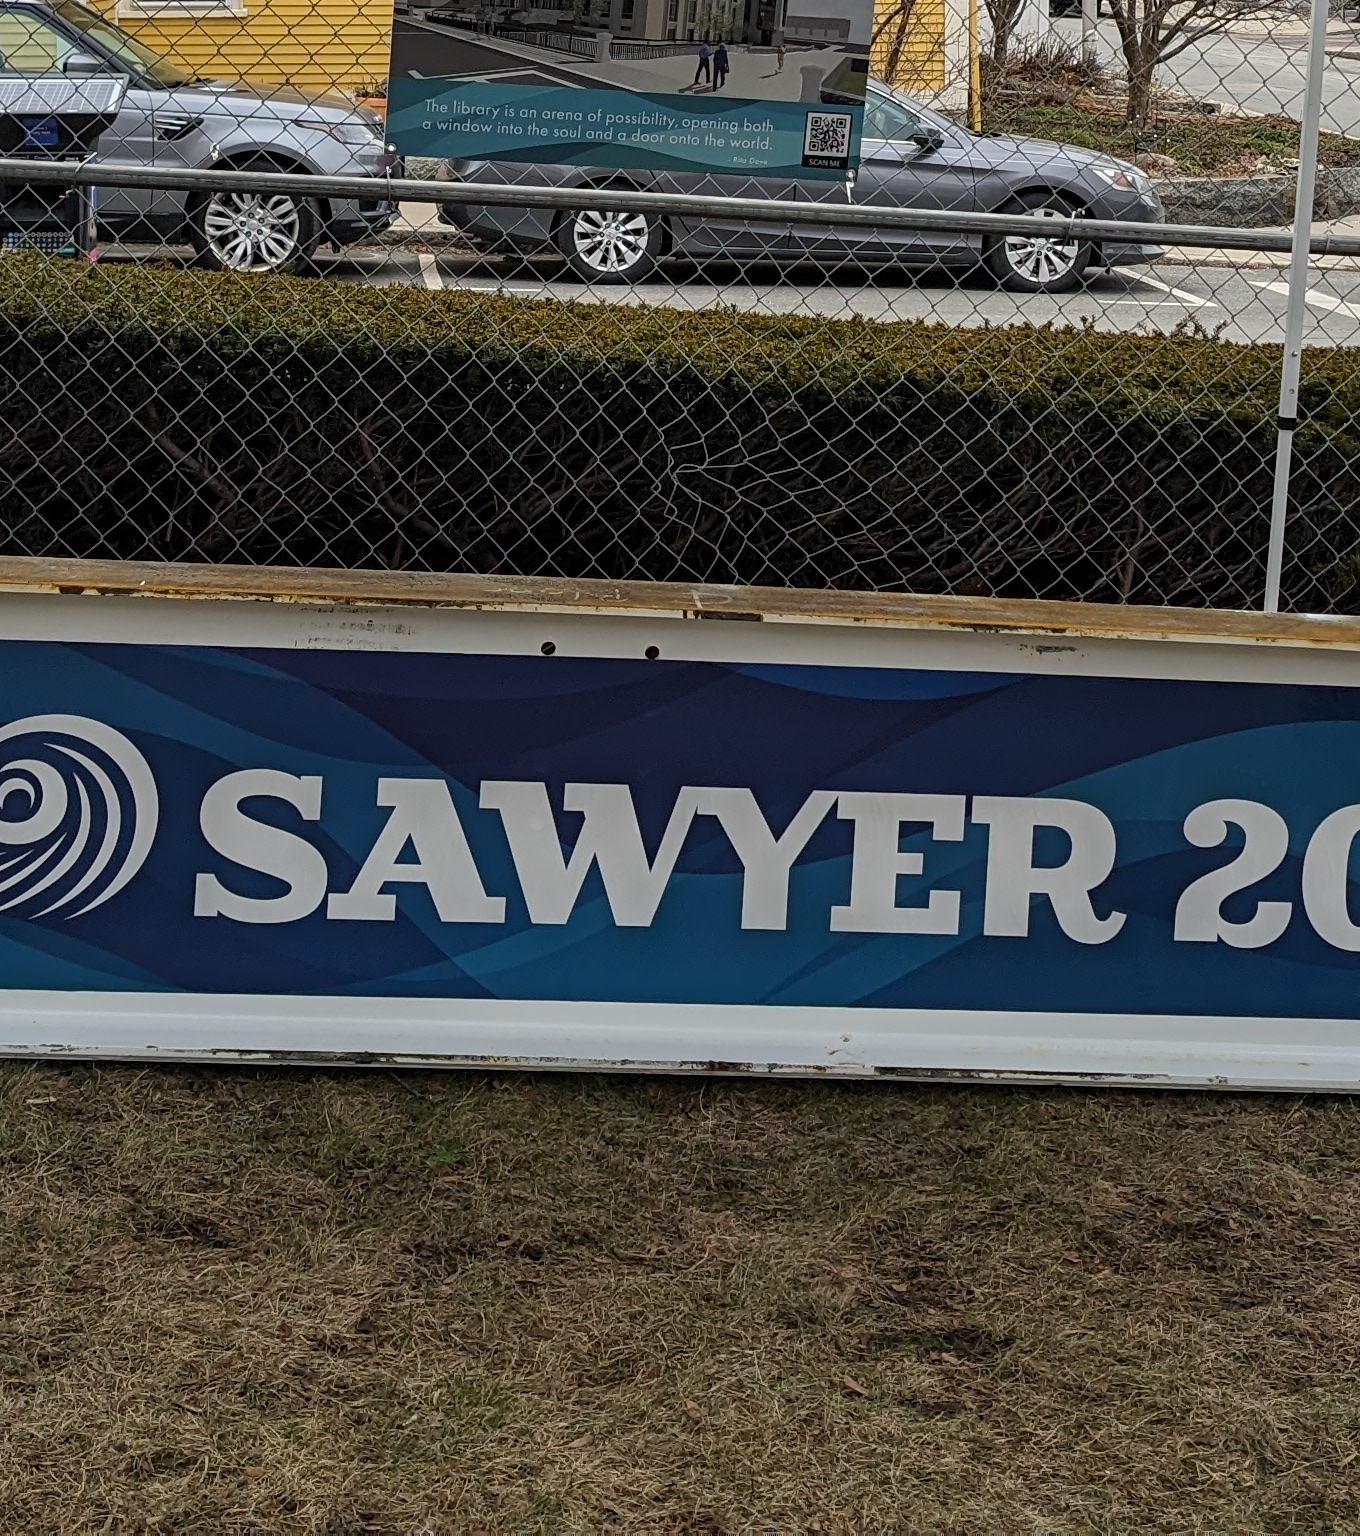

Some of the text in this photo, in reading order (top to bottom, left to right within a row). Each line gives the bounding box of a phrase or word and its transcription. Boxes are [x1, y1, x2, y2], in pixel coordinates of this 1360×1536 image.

[424, 99, 773, 133] The library is an arena of possibility, opening both
[422, 117, 773, 150] a window into the soul and a door onto the world.
[808, 158, 828, 166] SCAN
[193, 767, 1127, 946] SAWYER
